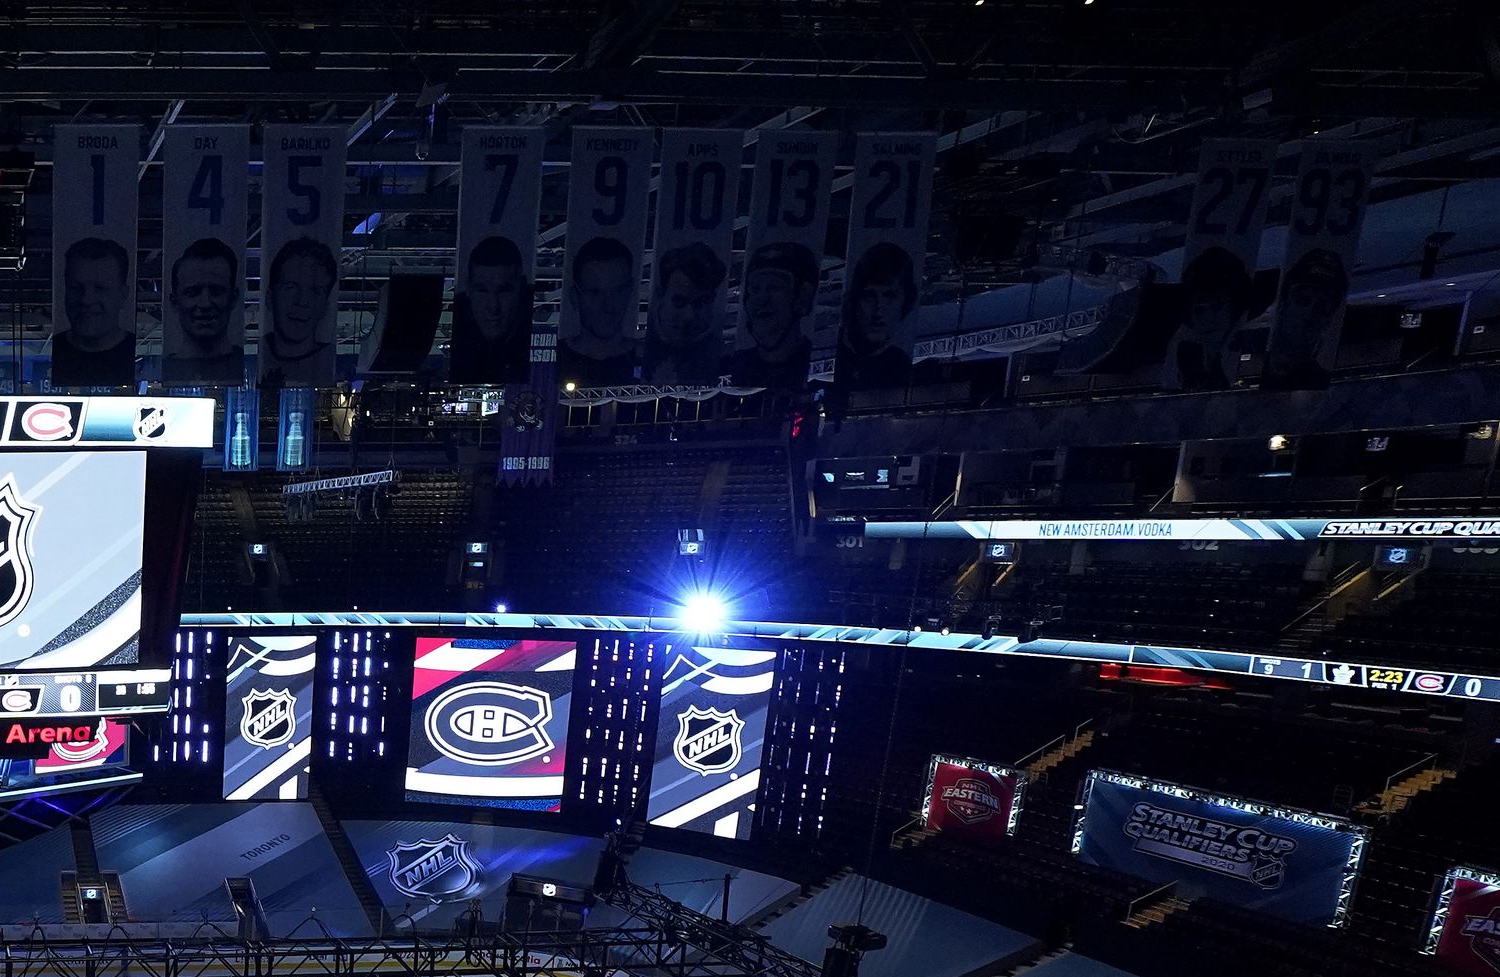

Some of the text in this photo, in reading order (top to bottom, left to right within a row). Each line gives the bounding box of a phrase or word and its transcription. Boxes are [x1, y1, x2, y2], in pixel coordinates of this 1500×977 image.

[194, 136, 219, 150] DAY
[479, 136, 527, 149] HORTON
[585, 138, 639, 153] KENNEDY
[90, 154, 105, 225] 1
[187, 155, 225, 225] 4
[286, 155, 323, 226] 5
[484, 154, 519, 225] 7
[592, 156, 629, 226] 9
[672, 161, 726, 231] 10
[767, 159, 819, 228] 13
[864, 160, 921, 229] 21
[1200, 167, 1269, 235] 27
[1295, 168, 1365, 235] 93
[1038, 522, 1174, 538] NEW AMSTERDAM VODKA
[1324, 522, 1412, 535] STANLEY
[1409, 522, 1454, 535] CUP
[1264, 662, 1312, 679] 9 1
[1368, 669, 1405, 685] 2:23
[60, 684, 82, 712] 0
[1464, 677, 1483, 698] 0
[6, 723, 92, 745] Arena
[252, 704, 287, 736] NHL
[687, 726, 727, 758] NHL
[943, 788, 1000, 810] EASTERN
[1126, 821, 1251, 863] QUALIFIERS
[1131, 803, 1297, 854] STANLEY CUP
[238, 832, 293, 861] TORONTO
[402, 850, 454, 890] NHL
[1201, 856, 1237, 872] 2020
